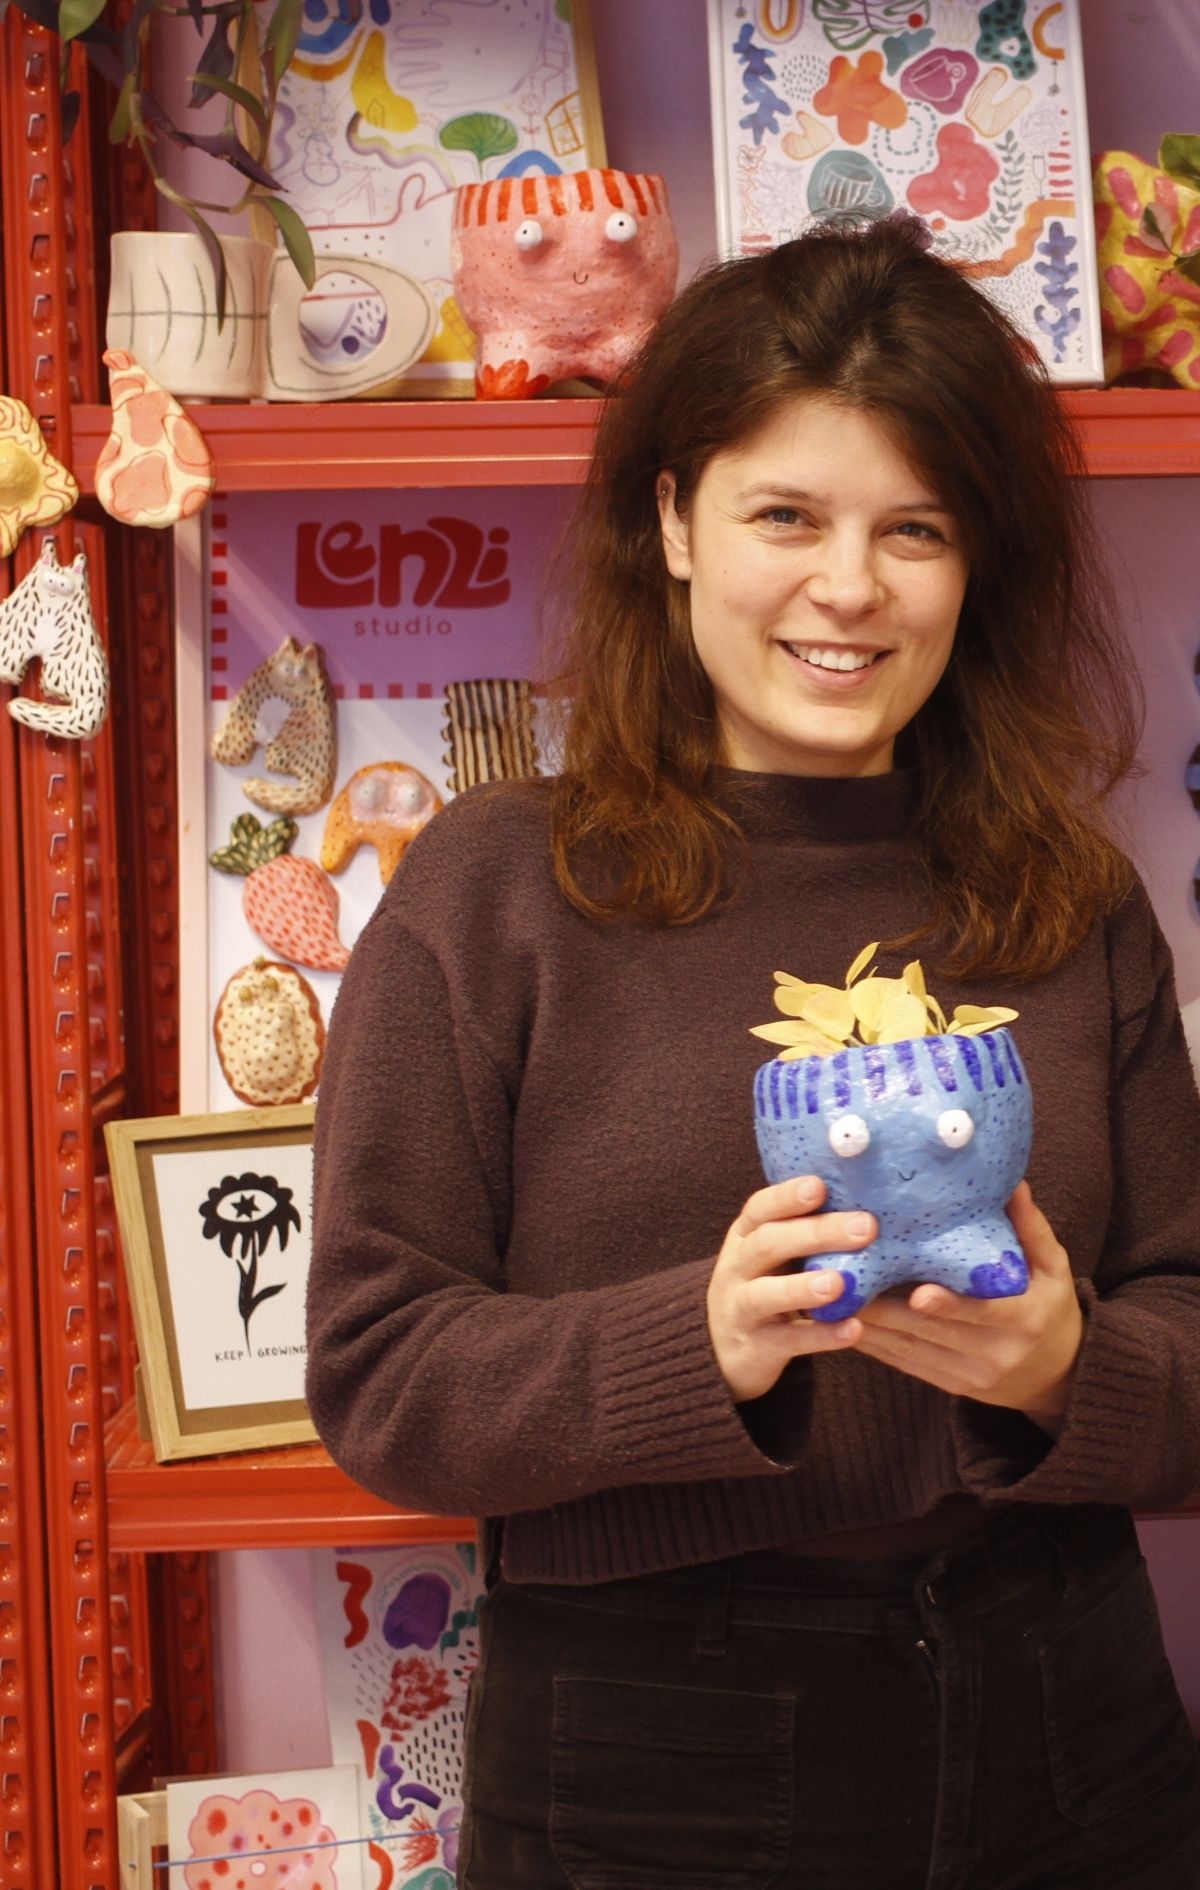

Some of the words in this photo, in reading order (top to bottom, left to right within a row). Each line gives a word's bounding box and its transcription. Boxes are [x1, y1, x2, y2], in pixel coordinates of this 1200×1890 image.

[354, 616, 452, 636] studio
[215, 1350, 244, 1362] KEEP
[258, 1345, 306, 1358] GROWING
